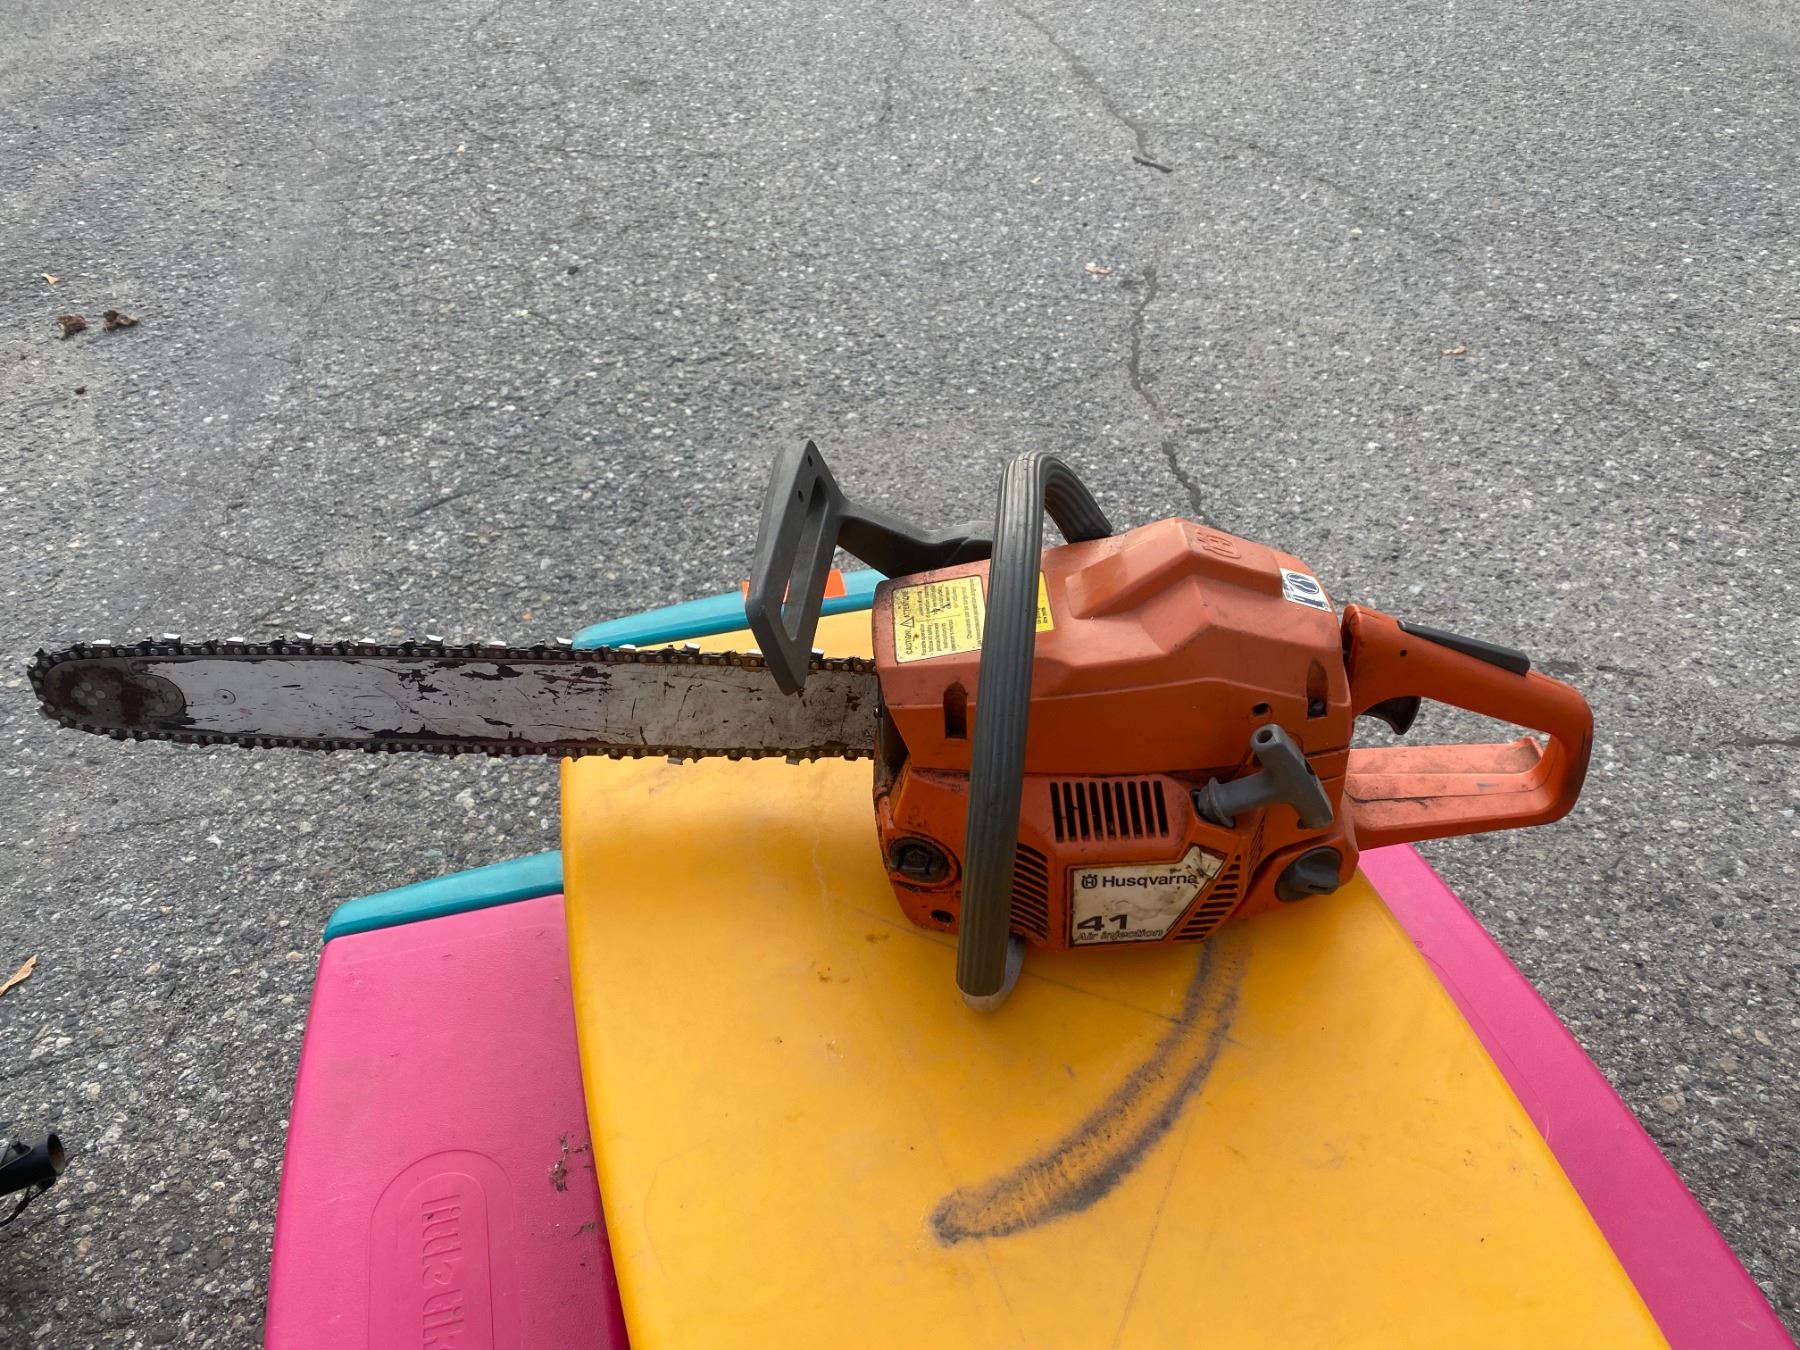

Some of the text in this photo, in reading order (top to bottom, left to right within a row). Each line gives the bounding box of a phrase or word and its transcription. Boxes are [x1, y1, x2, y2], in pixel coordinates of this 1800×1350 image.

[1102, 874, 1197, 888] Husqvarna
[1077, 914, 1128, 931] 41
[1077, 932, 1099, 941] Air
[423, 1289, 465, 1350] tik
